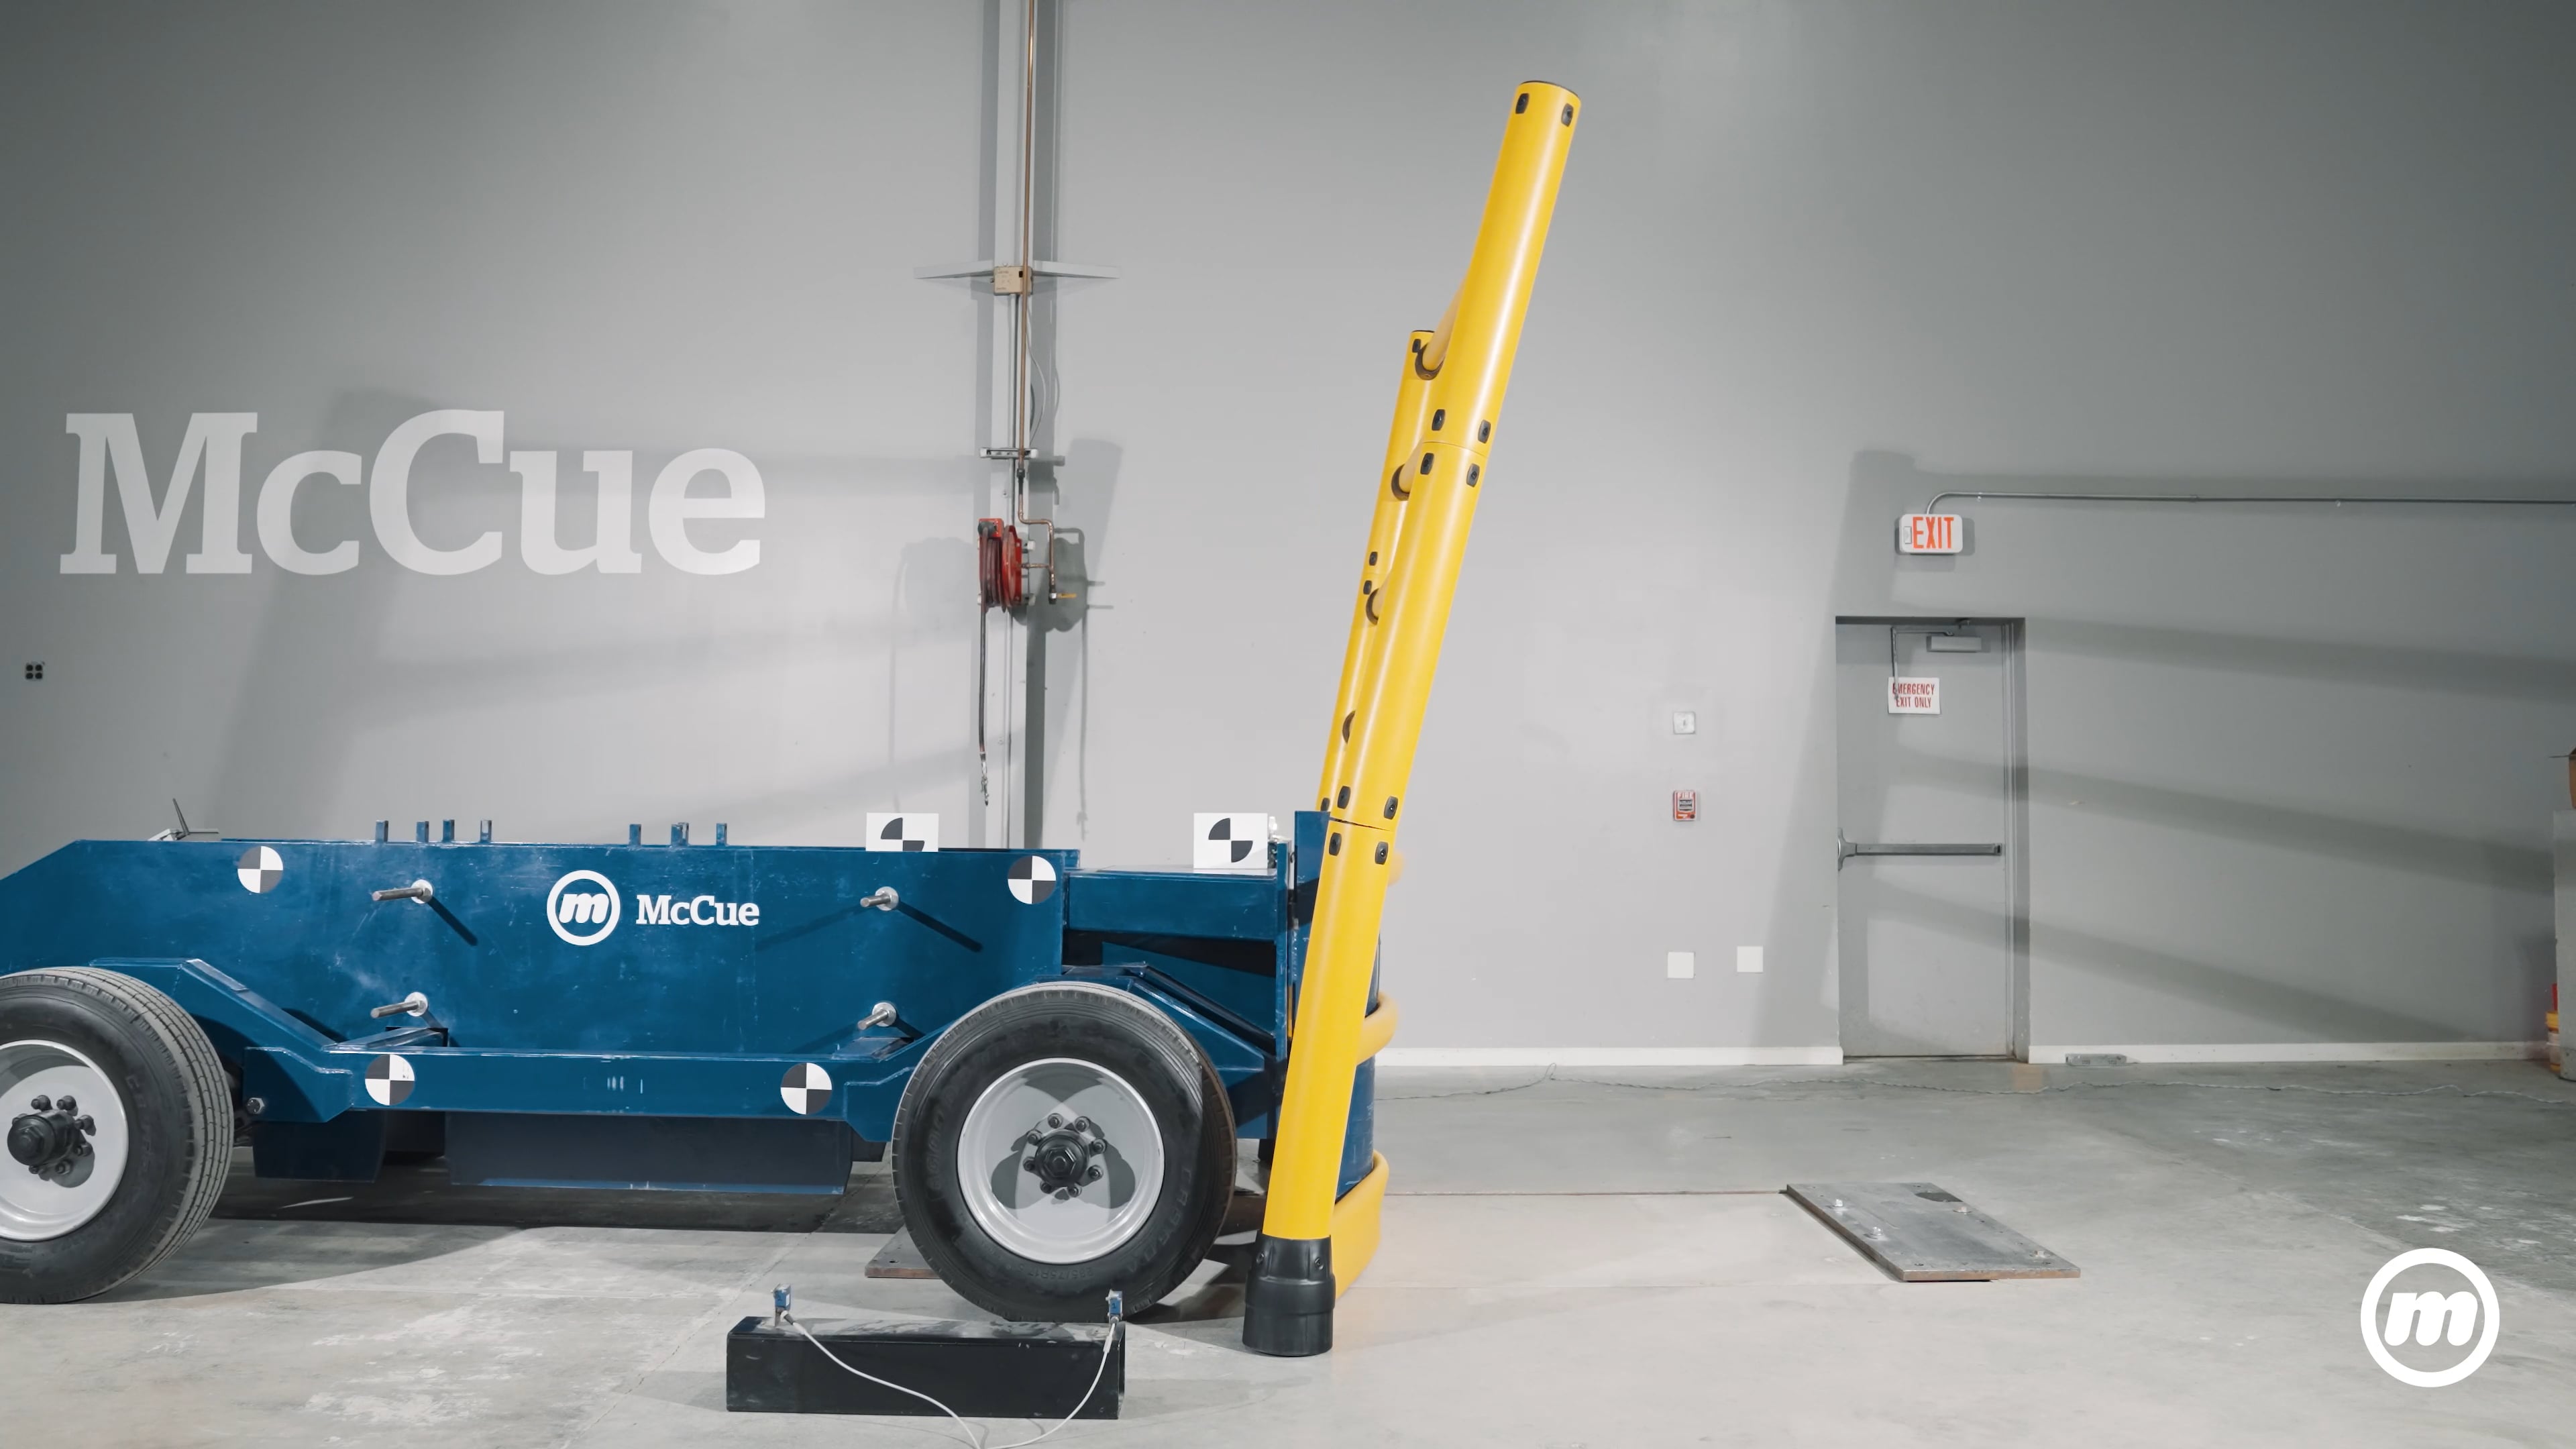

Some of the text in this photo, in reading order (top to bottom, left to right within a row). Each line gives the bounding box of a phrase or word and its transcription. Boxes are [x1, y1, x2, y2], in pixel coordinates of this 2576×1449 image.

[60, 409, 765, 576] McCue
[1913, 517, 1954, 549] EXIT
[1892, 682, 1935, 695] EMERGENCY
[1896, 696, 1931, 708] EXIT ONLY
[636, 894, 760, 926] McCue
